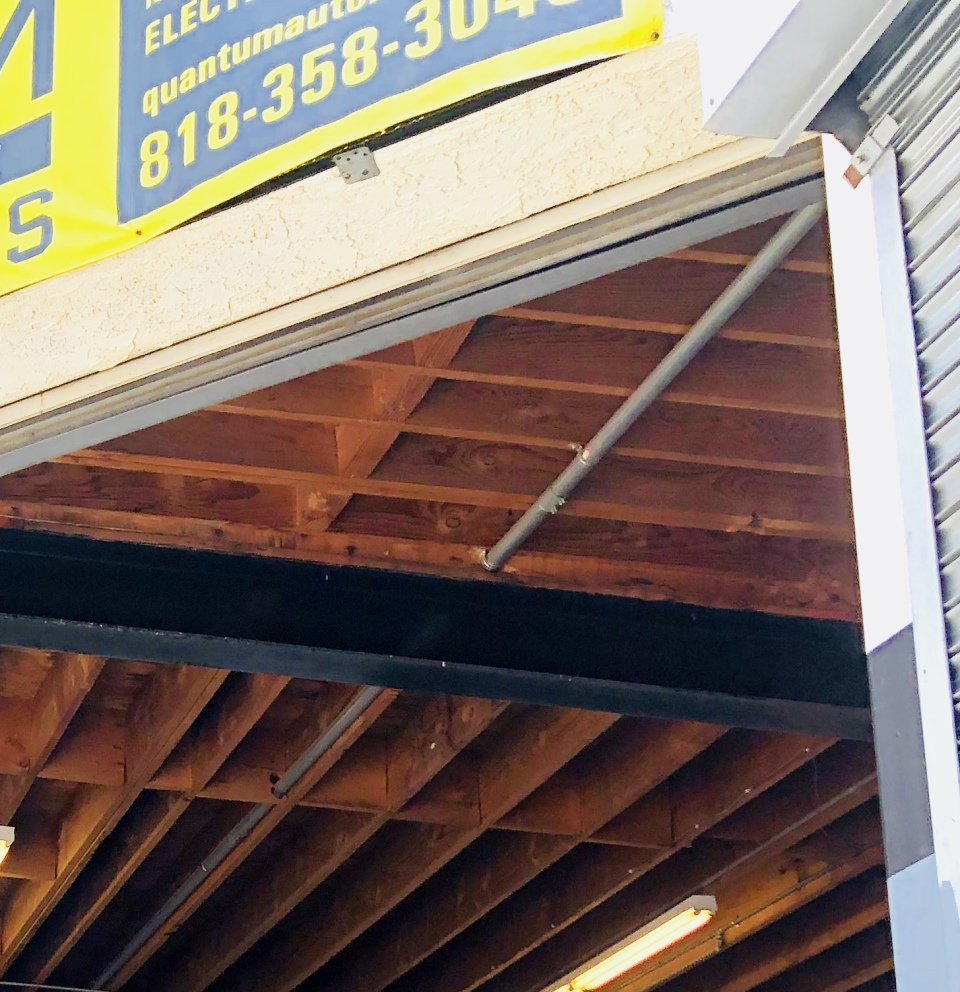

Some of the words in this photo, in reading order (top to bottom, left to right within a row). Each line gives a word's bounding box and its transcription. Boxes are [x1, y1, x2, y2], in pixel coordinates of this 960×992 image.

[142, 0, 378, 117] quantumauto
[144, 0, 254, 56] ELEC
[139, 0, 587, 189] 818-358-30
